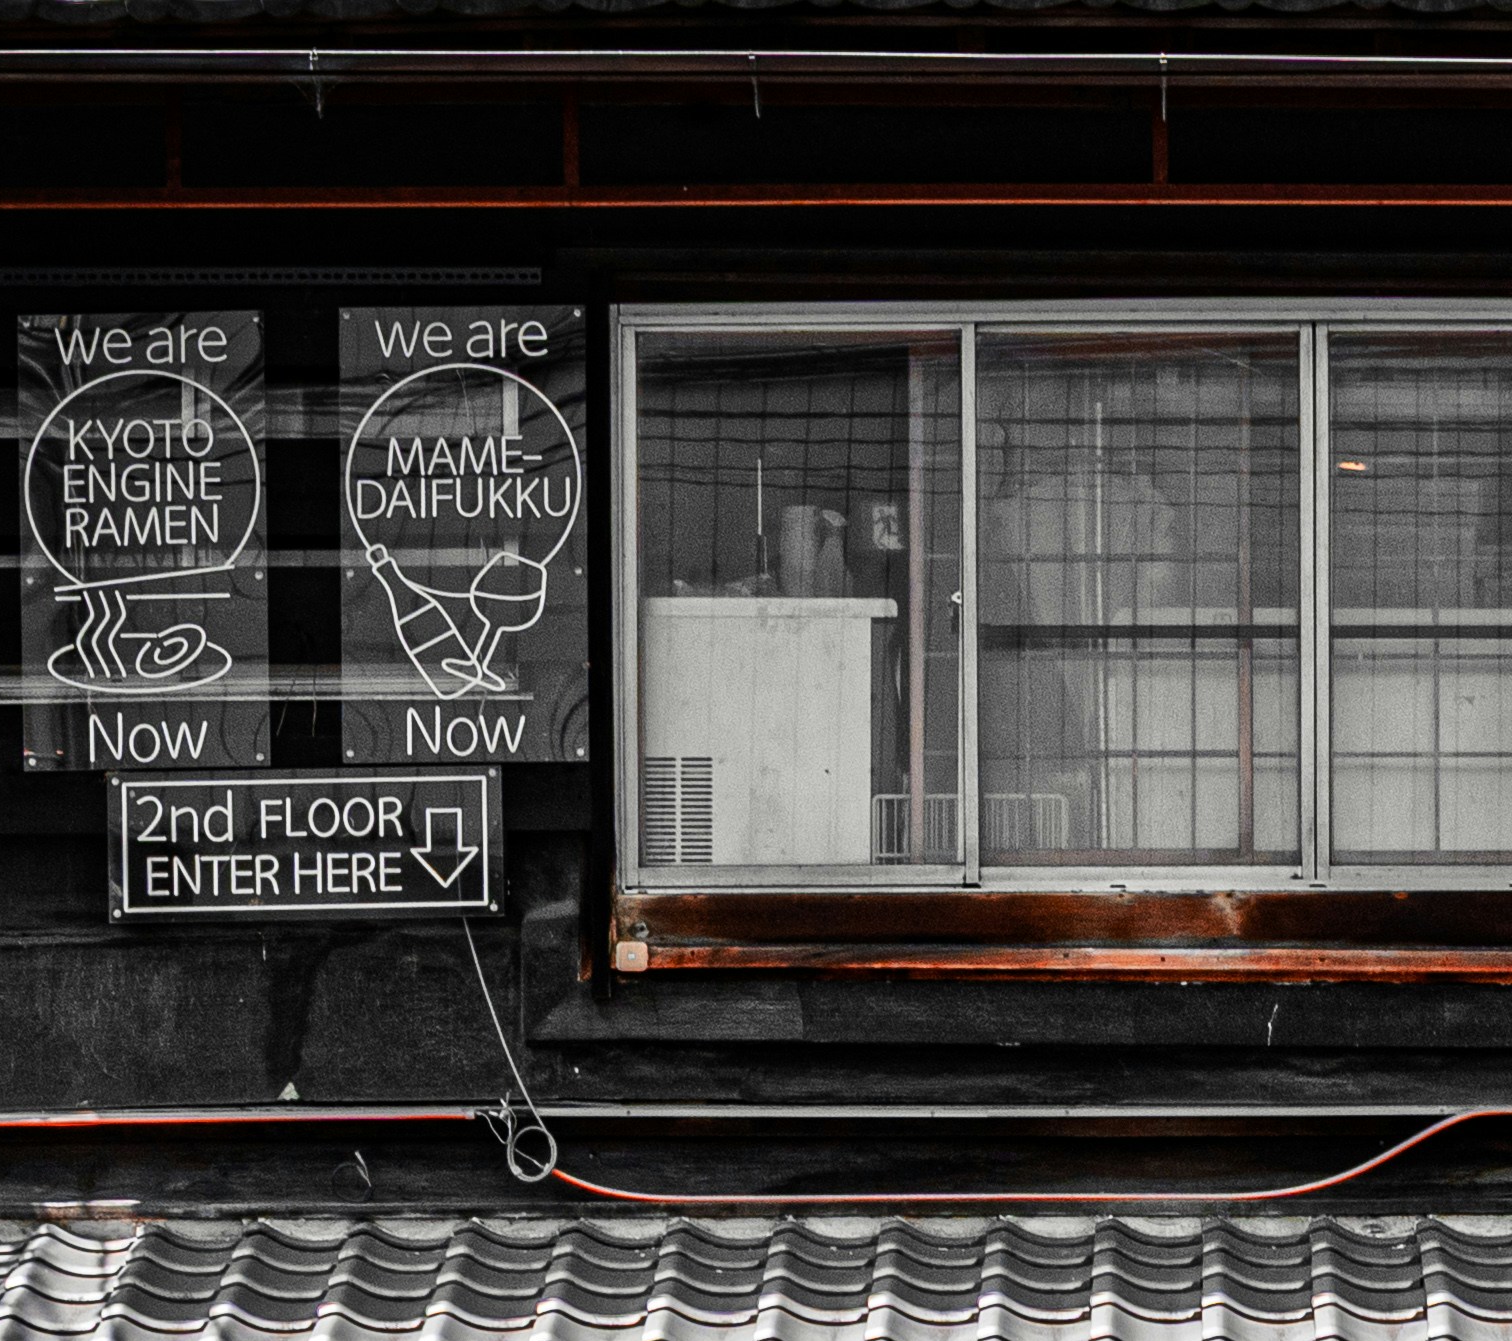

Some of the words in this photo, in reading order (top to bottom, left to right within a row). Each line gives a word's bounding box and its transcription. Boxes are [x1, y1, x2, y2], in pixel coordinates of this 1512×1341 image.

[56, 330, 136, 368] we
[147, 325, 229, 364] are
[375, 322, 453, 359] we
[464, 319, 549, 358] are
[68, 420, 214, 460] KYOTO
[387, 436, 543, 475] MAME-
[62, 463, 223, 503] ENGINE
[357, 477, 572, 520] DAIFUKKU
[65, 505, 220, 548] RAMEN
[89, 714, 208, 763] Now
[406, 707, 526, 756] Now
[136, 792, 234, 843] 2nd
[260, 798, 403, 841] FLOOR
[147, 855, 278, 896] ENTER
[293, 852, 403, 894] HERE
